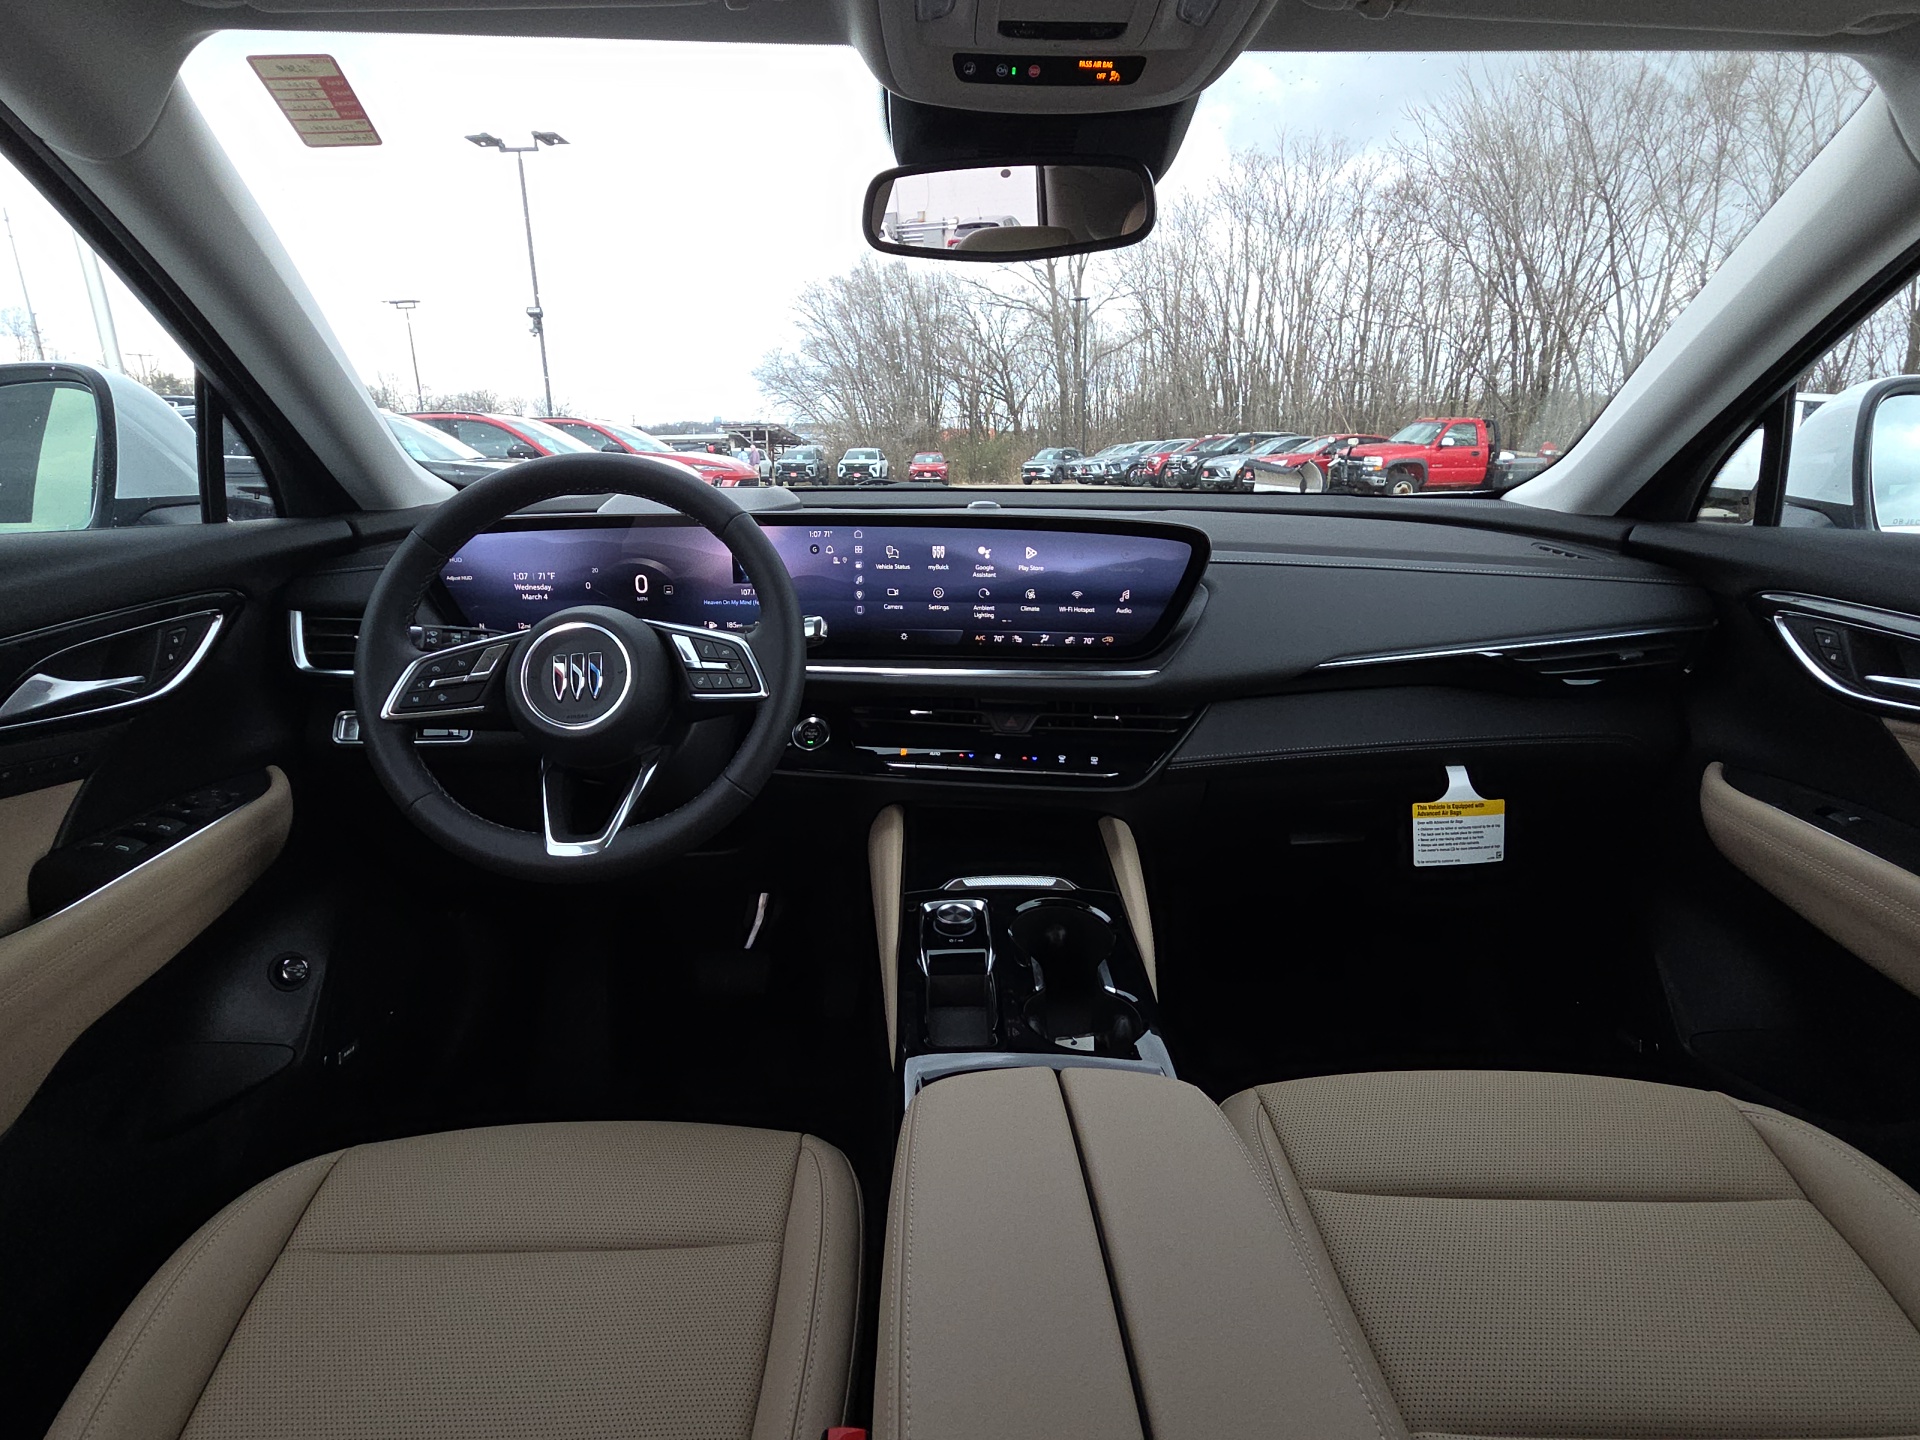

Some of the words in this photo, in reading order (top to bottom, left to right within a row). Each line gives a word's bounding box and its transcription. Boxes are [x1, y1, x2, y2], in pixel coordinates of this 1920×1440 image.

[1079, 60, 1092, 68] PASS
[1093, 60, 1102, 68] AIR
[1102, 60, 1113, 69] BAG
[1096, 72, 1107, 80] OFF
[809, 530, 821, 538] 1:07
[927, 563, 950, 572] myBuick
[975, 564, 995, 572] Google
[1018, 564, 1030, 572] Play
[512, 572, 529, 580] 1:07
[634, 574, 648, 593] 0
[730, 599, 739, 607] My
[928, 604, 950, 612] Settings
[1073, 606, 1096, 614] Hotspot
[973, 612, 995, 620] Lighting
[1452, 802, 1474, 810] Equipped
[1449, 809, 1462, 817] Bags
